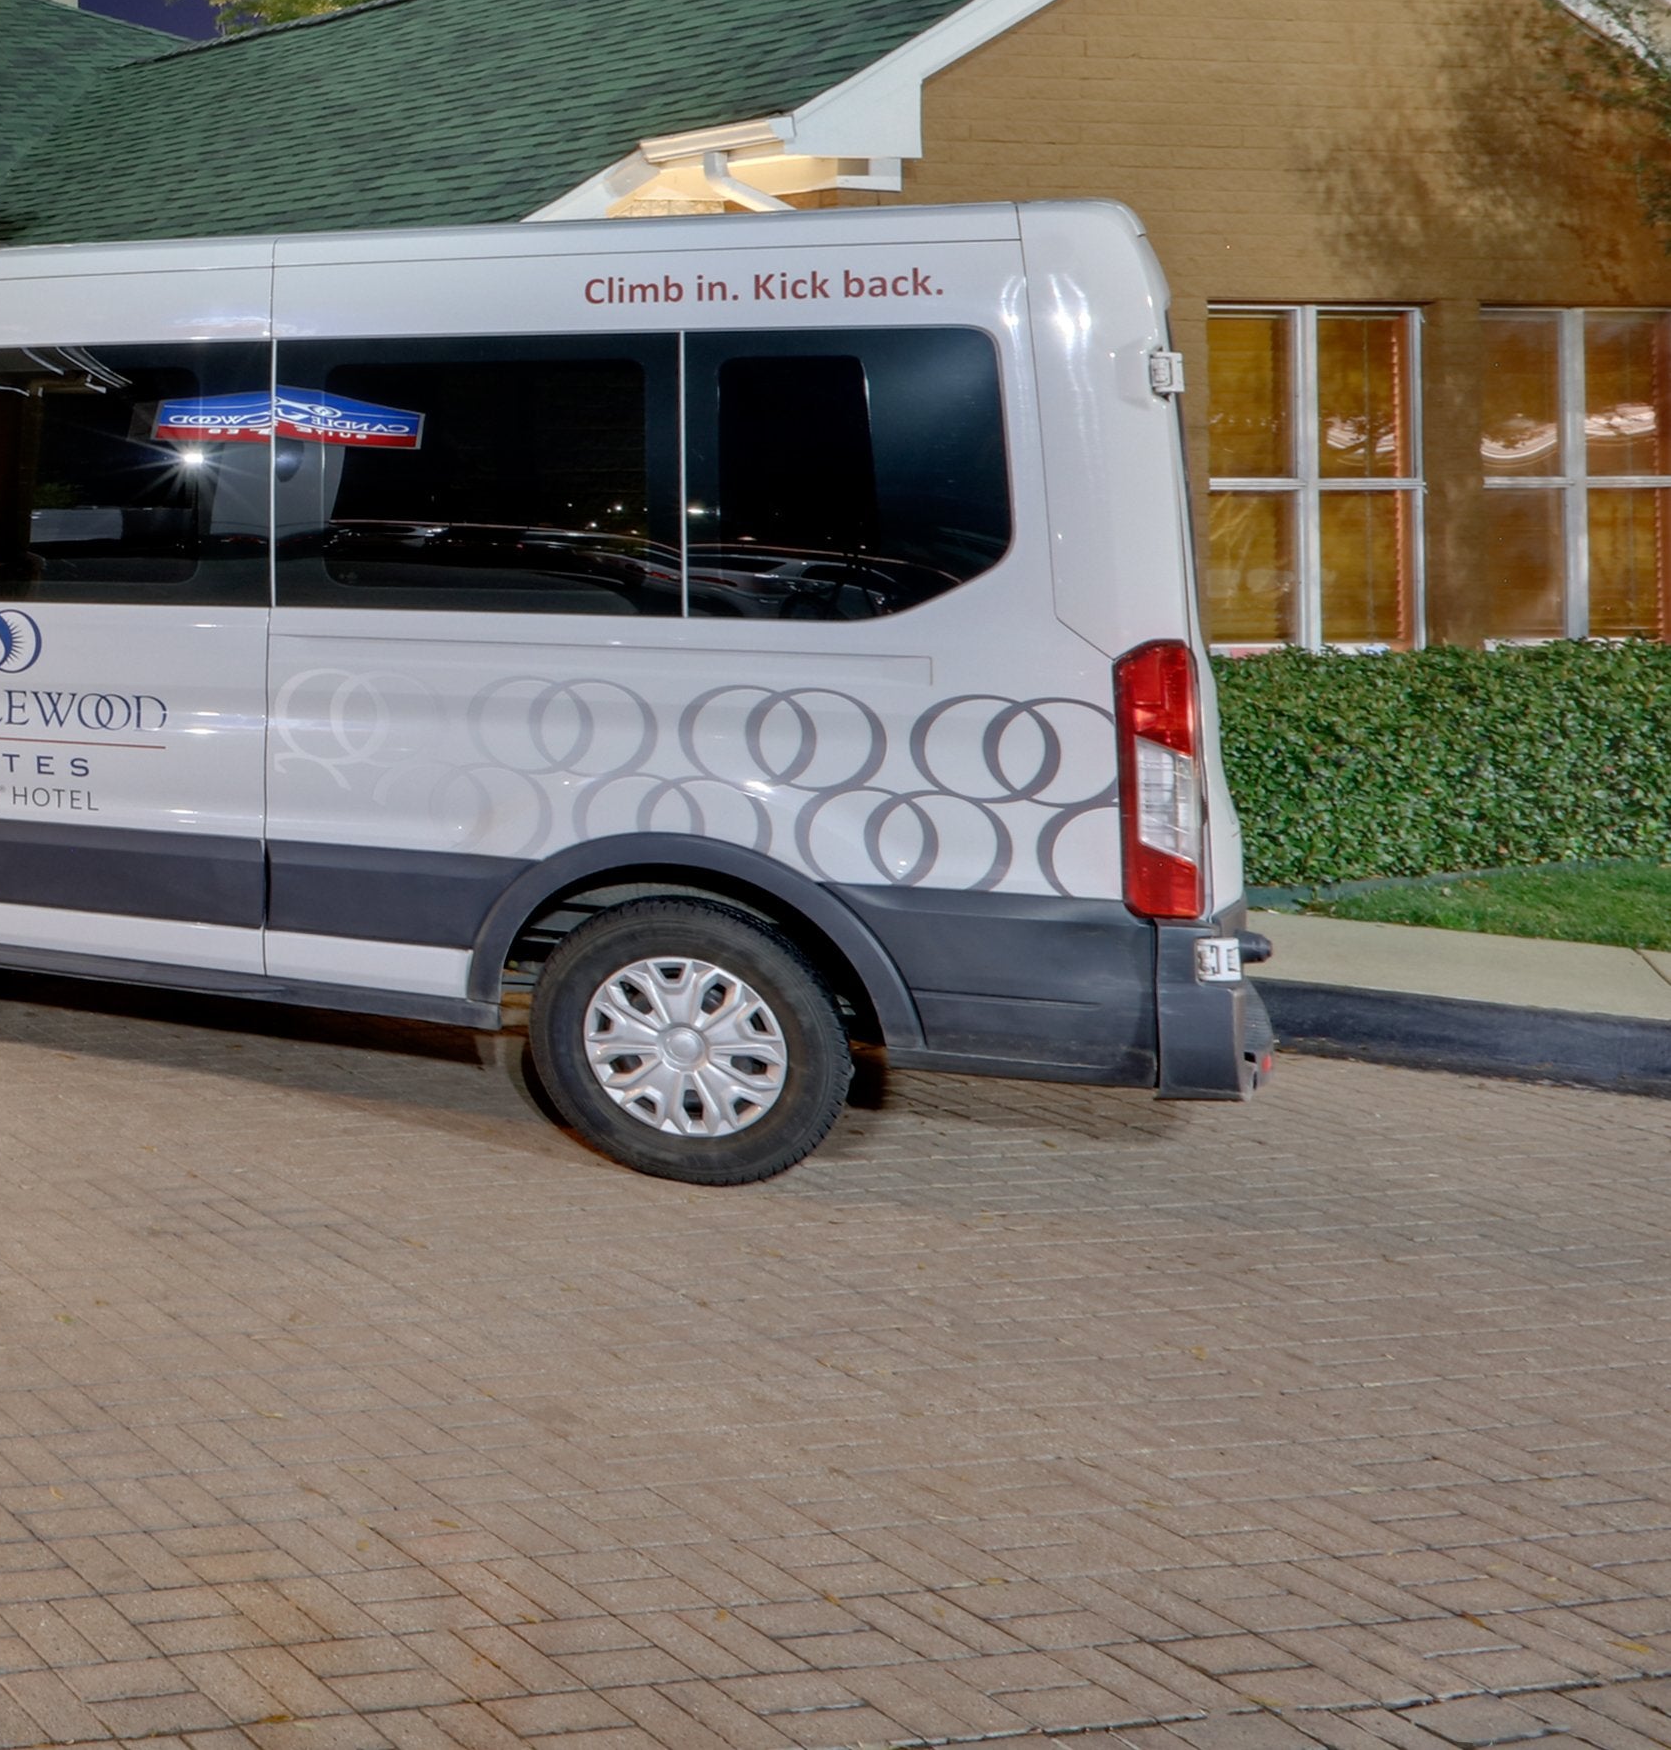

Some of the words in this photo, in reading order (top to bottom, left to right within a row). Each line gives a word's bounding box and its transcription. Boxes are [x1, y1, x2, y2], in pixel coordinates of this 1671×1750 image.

[584, 275, 684, 304] Climb
[697, 275, 739, 302] in.
[754, 271, 830, 300] Kick
[844, 268, 944, 298] back.
[12, 786, 100, 812] HOTEL
